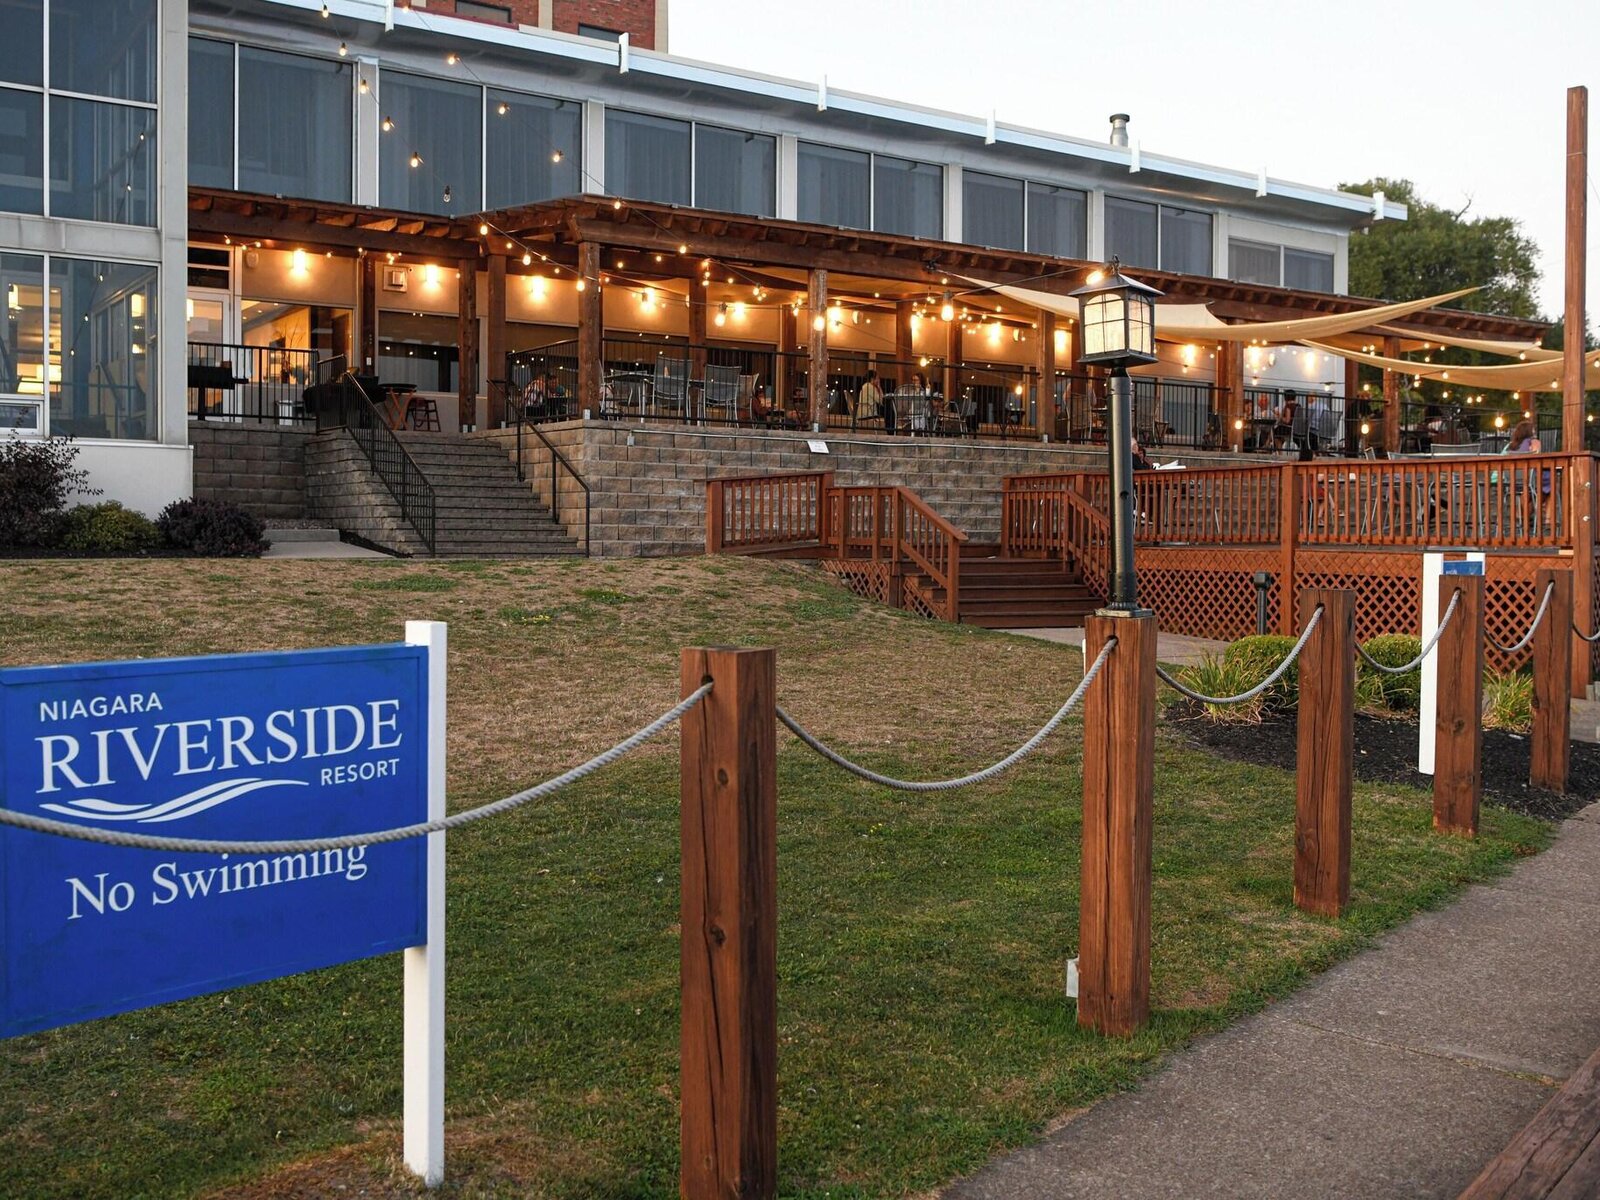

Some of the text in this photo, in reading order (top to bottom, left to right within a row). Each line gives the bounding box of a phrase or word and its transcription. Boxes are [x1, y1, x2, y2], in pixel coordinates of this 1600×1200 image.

[40, 692, 163, 721] NIAGARA
[35, 699, 402, 793] RIVERSIDE
[321, 758, 400, 785] RESORT
[66, 845, 368, 919] No Swimming
